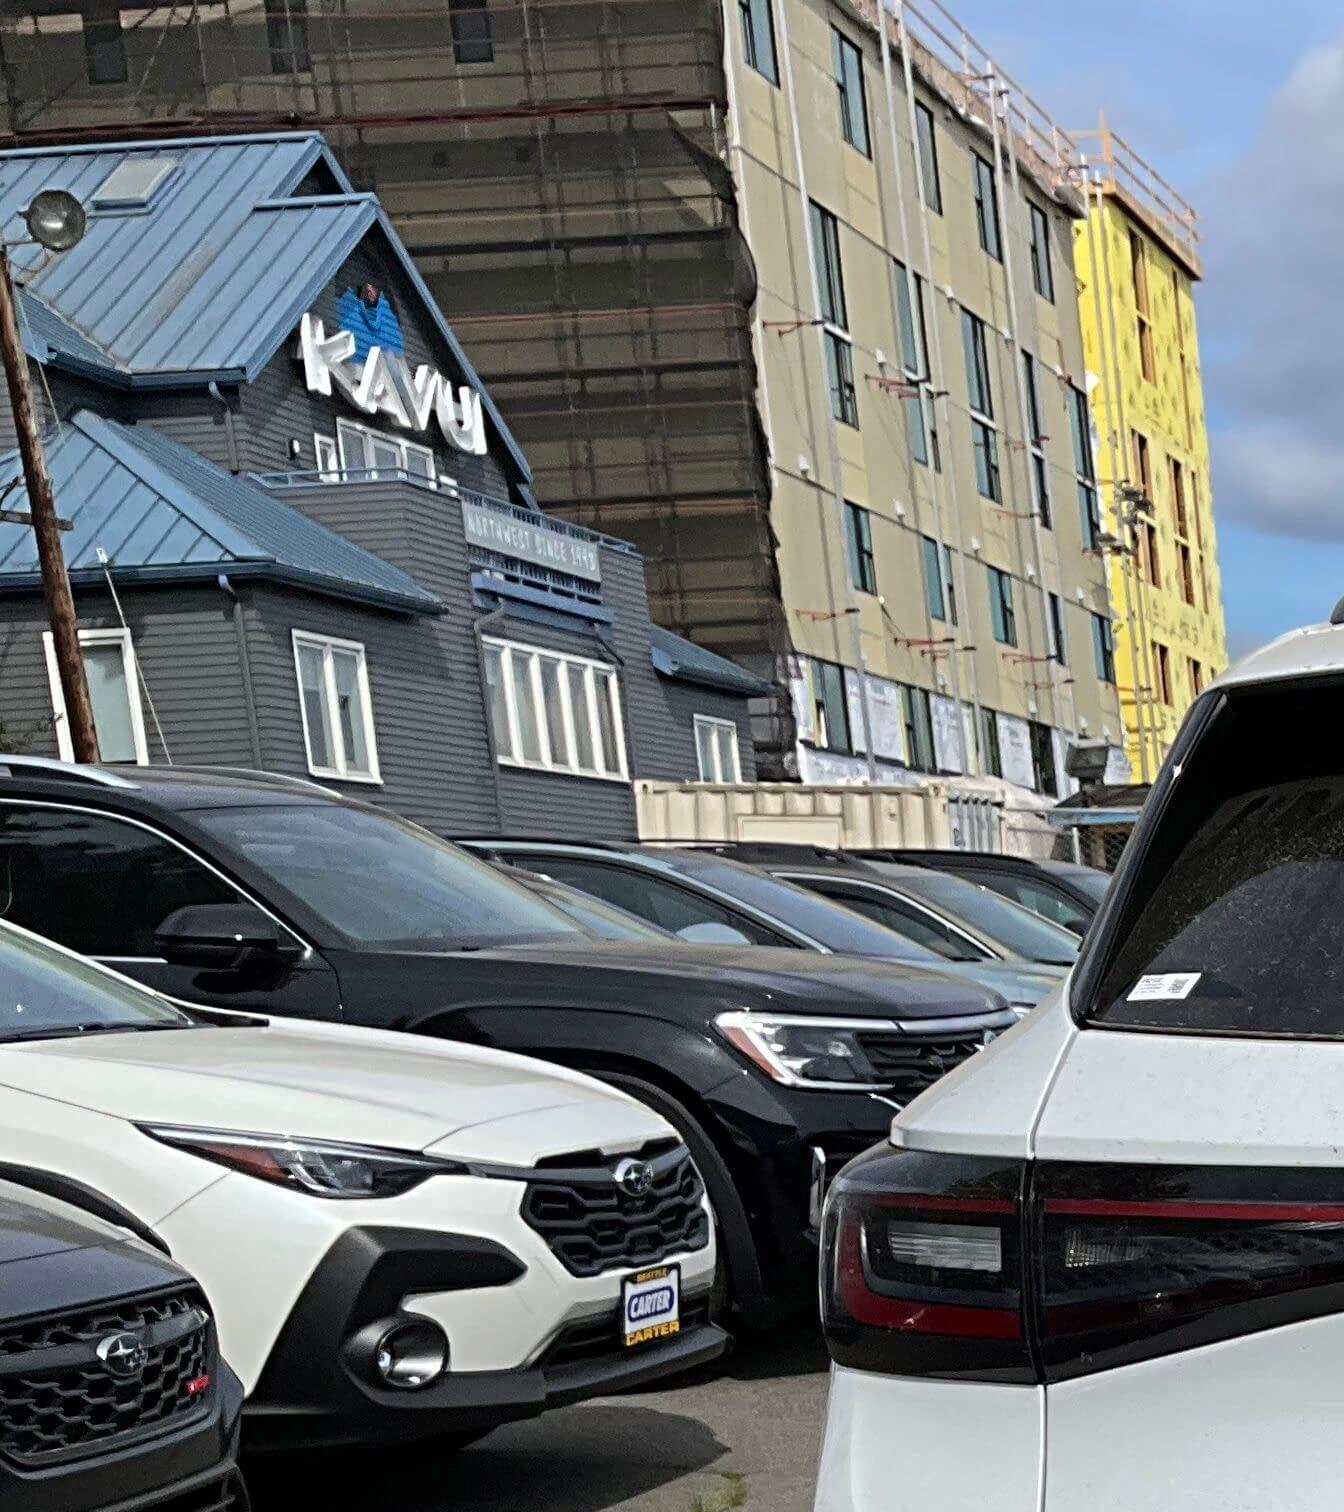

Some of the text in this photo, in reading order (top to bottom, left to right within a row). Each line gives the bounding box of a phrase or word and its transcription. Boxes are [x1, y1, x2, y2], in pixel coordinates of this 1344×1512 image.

[300, 312, 488, 455] KAVU
[630, 1290, 671, 1319] CARTER
[626, 1321, 679, 1346] CARTER
